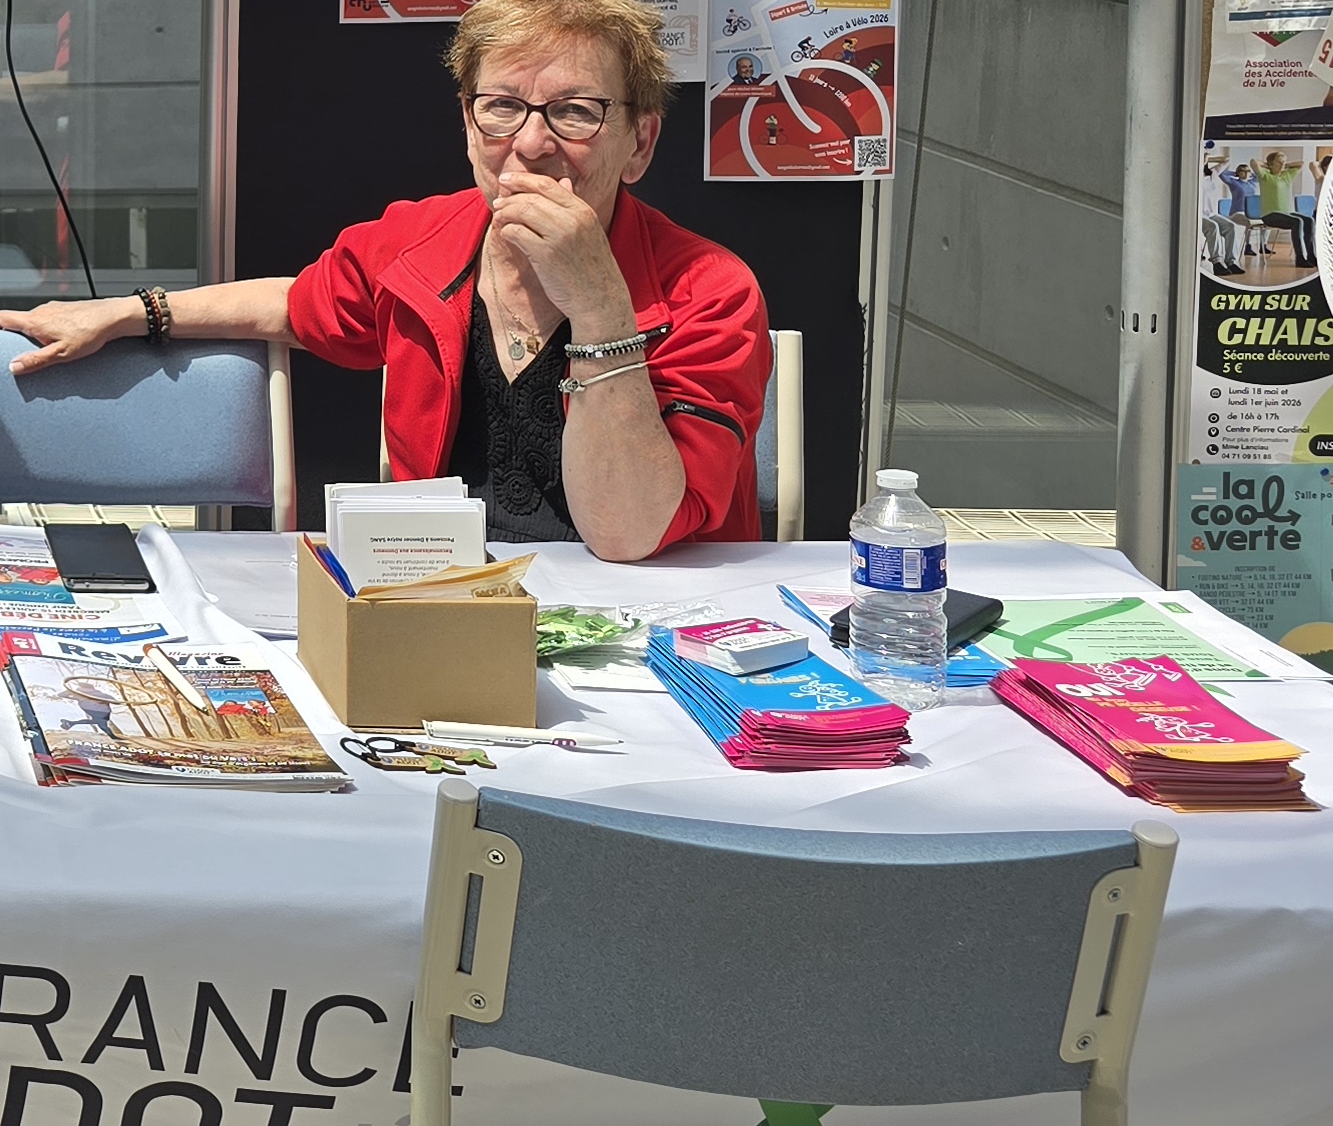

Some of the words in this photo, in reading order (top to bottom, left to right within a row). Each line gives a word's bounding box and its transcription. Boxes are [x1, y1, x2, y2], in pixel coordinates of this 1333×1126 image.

[1244, 59, 1303, 69] Association
[1210, 294, 1262, 311] GYM
[1264, 294, 1311, 311] SUR
[1223, 348, 1264, 361] Séance
[1267, 348, 1331, 361] découverte
[1222, 471, 1256, 500] la
[1294, 490, 1317, 501] Salle
